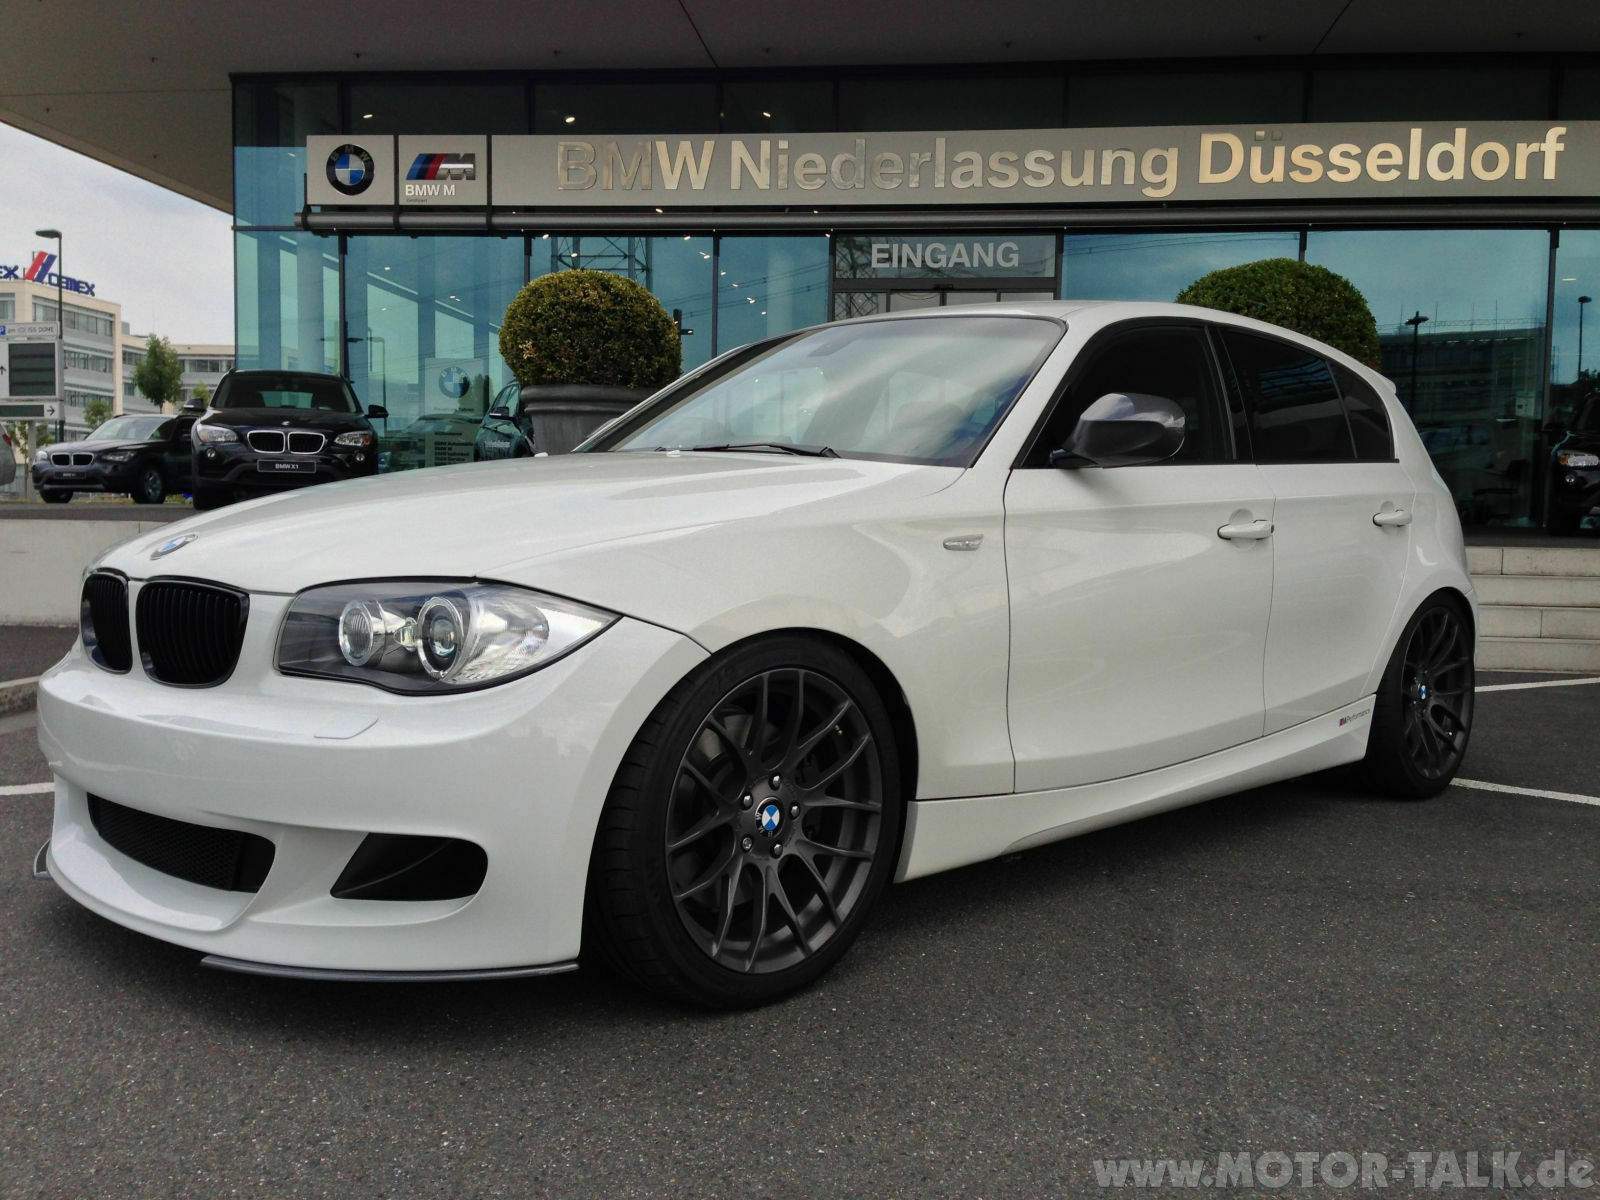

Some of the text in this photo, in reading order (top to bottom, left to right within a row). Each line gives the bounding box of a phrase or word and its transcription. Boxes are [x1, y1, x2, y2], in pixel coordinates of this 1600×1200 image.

[557, 127, 1567, 198] BMW Niederlassung Düsseldorf
[405, 184, 455, 196] BMW M
[871, 242, 1019, 268] EINGANG
